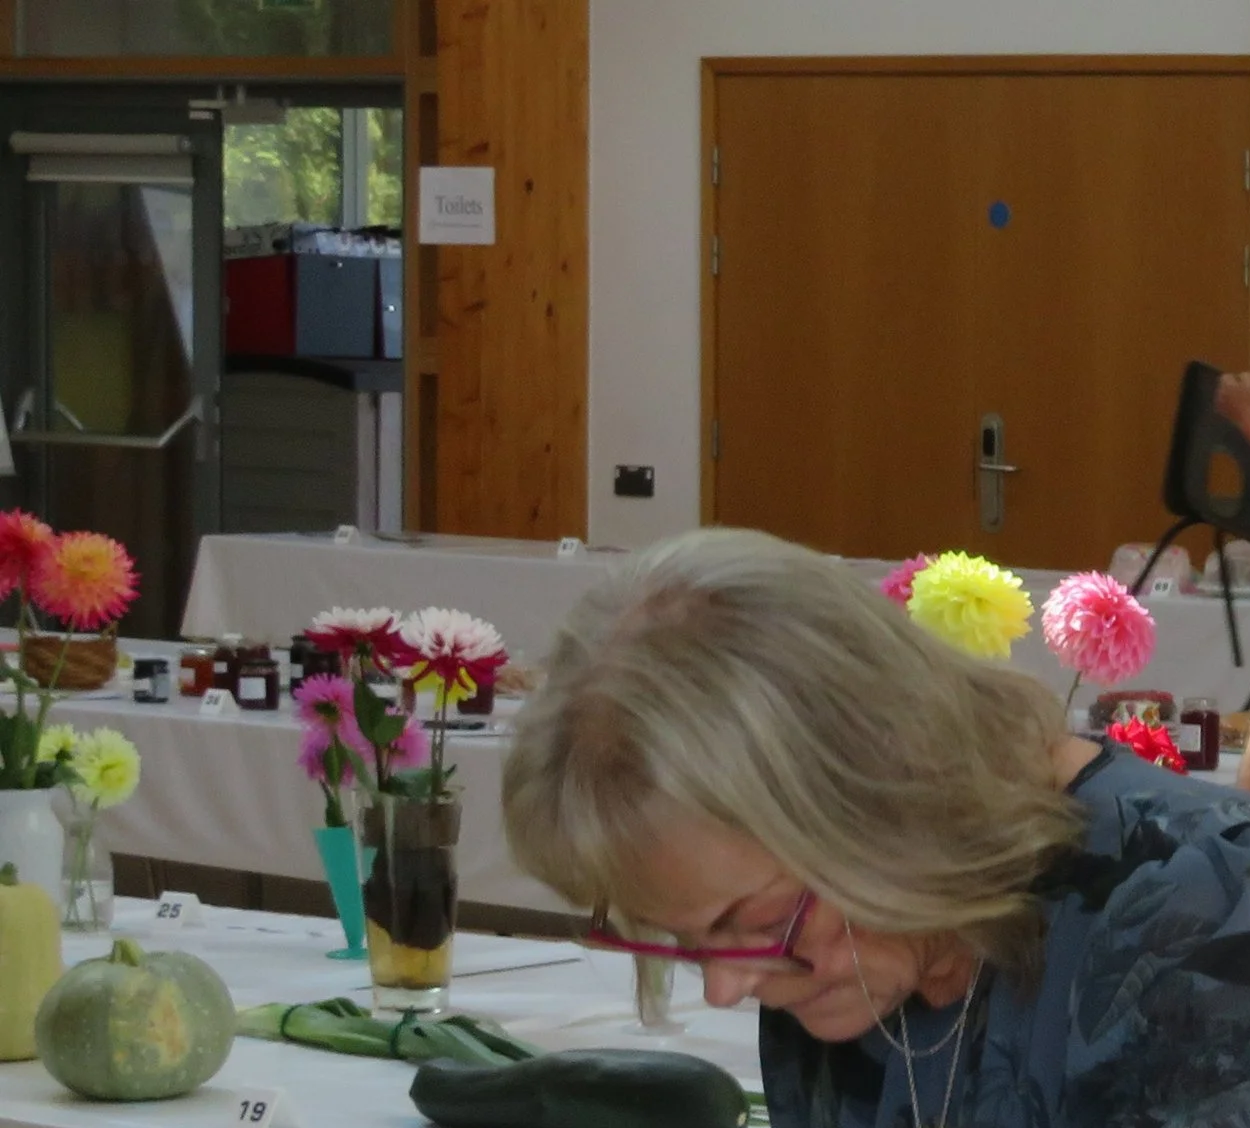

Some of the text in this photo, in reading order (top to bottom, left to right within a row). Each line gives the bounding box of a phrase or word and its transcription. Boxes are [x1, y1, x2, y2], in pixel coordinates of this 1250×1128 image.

[434, 194, 484, 216] Toilets
[156, 903, 183, 919] 25
[239, 1100, 268, 1122] 19
